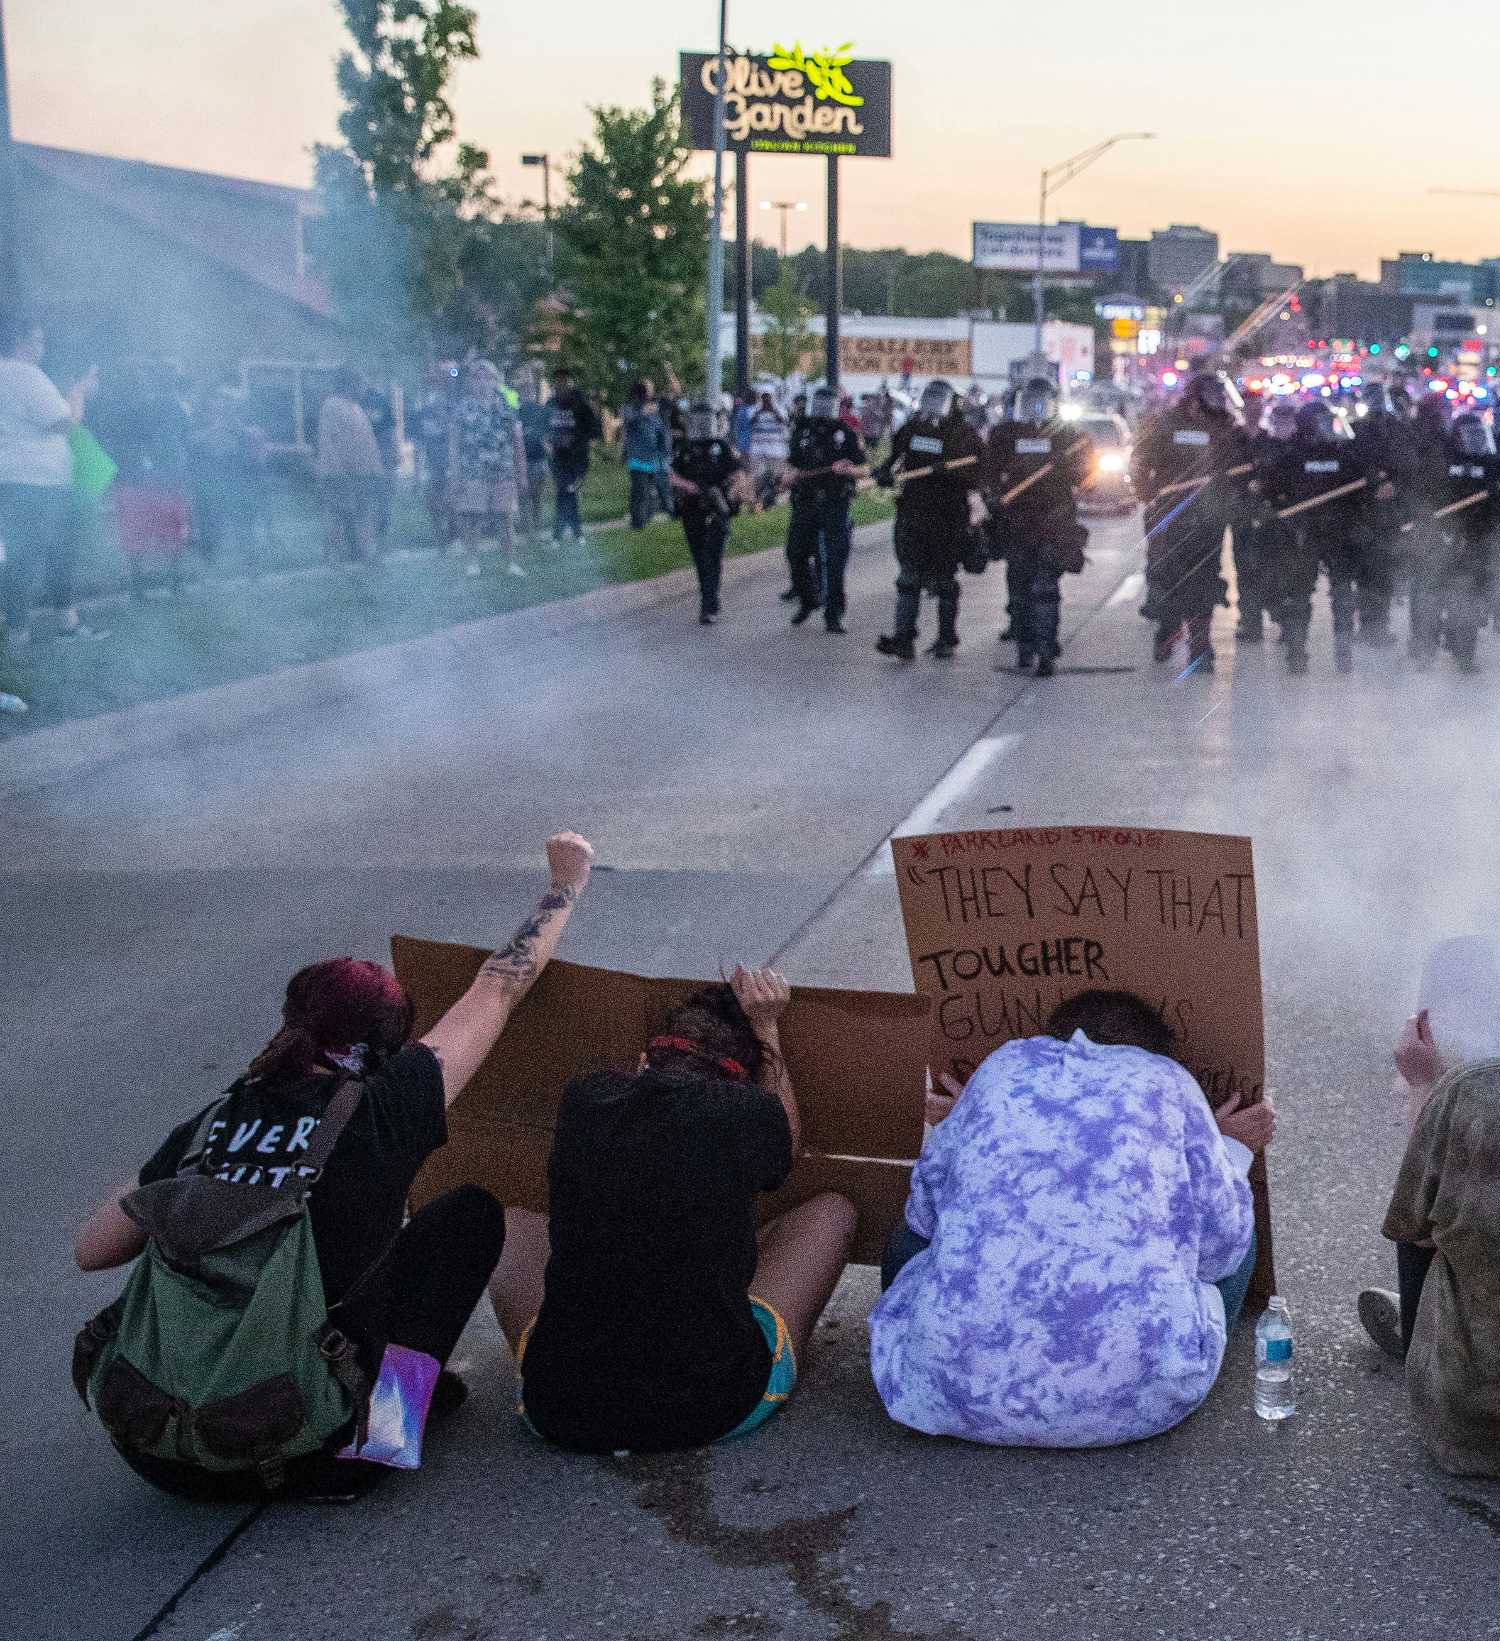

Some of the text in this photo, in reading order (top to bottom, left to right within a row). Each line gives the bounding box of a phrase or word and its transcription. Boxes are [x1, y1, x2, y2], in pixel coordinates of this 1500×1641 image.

[700, 56, 806, 99] Olive
[722, 95, 865, 141] Garden
[940, 828, 1165, 857] PARKLAND STRONG
[1050, 862, 1133, 923] SAY
[1146, 869, 1255, 938] THAT
[918, 937, 1110, 991] TOUGHER
[938, 990, 1043, 1041] GUN
